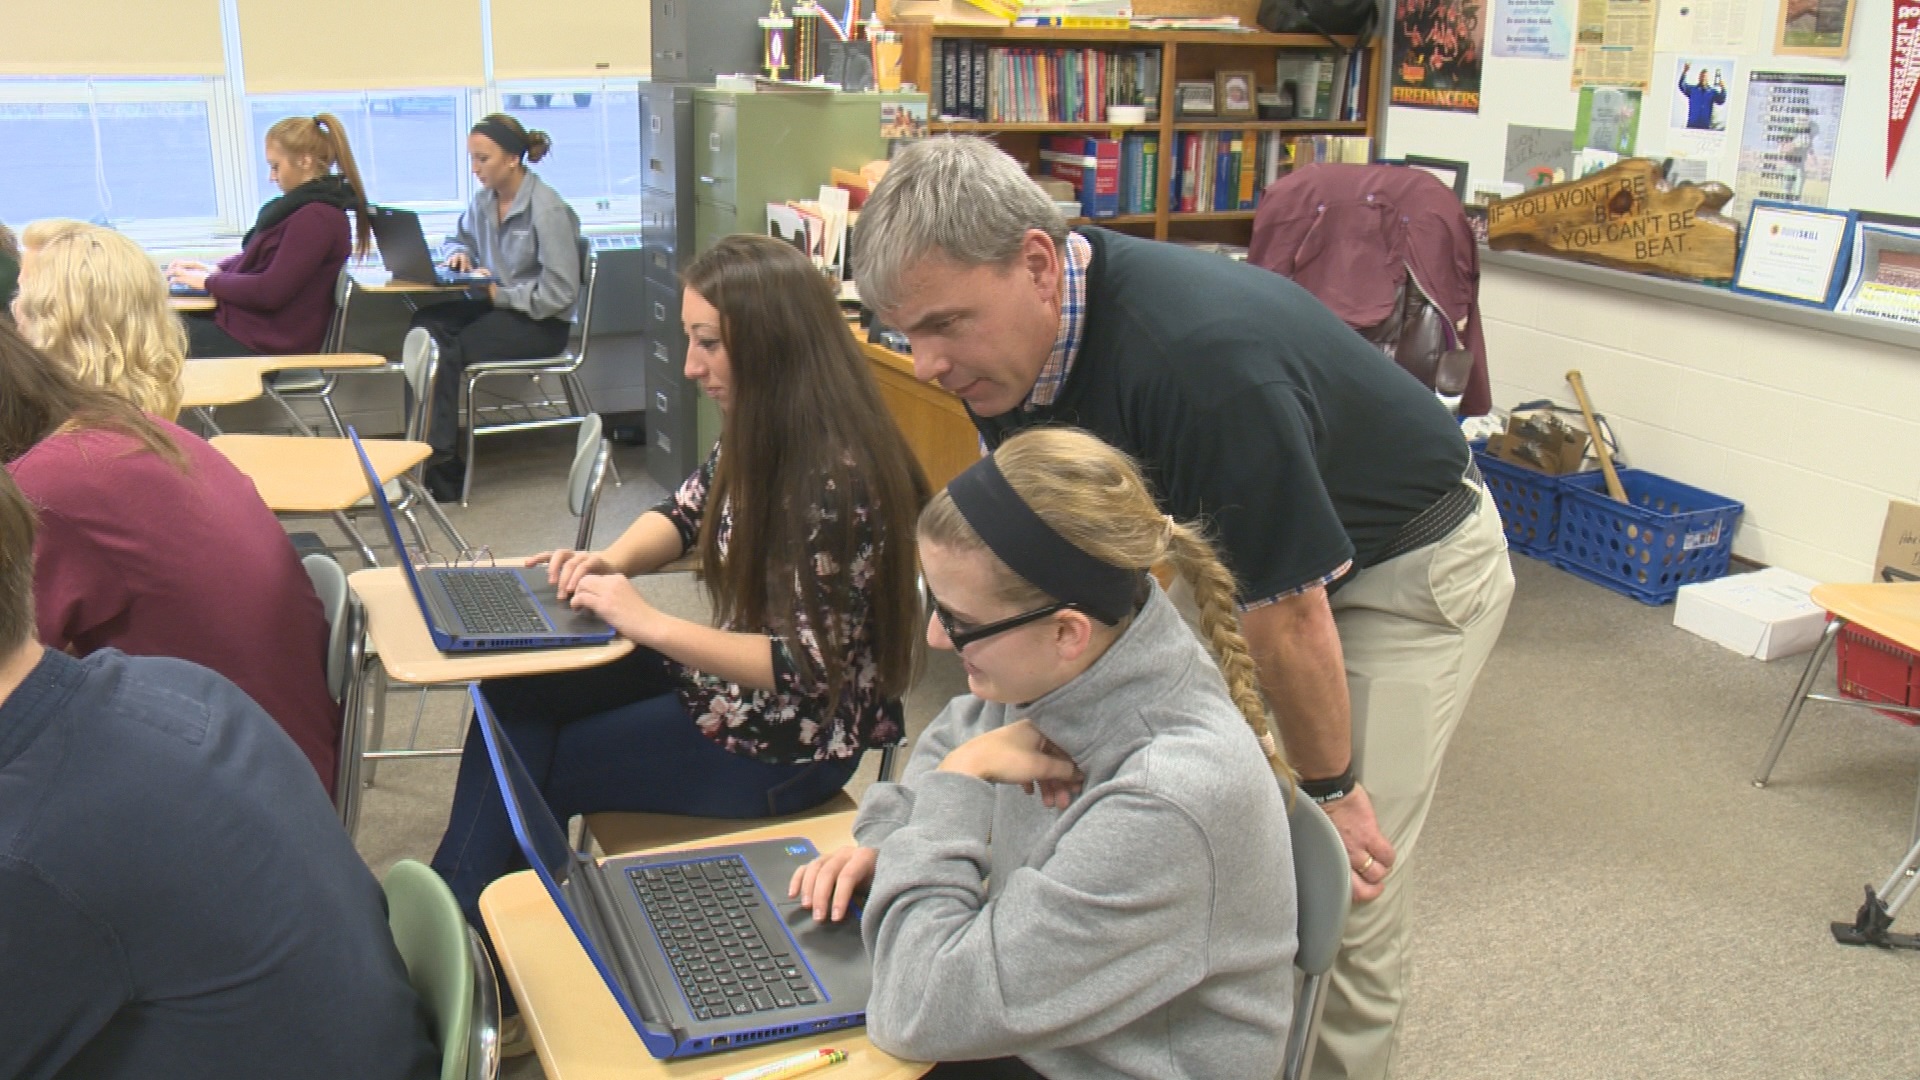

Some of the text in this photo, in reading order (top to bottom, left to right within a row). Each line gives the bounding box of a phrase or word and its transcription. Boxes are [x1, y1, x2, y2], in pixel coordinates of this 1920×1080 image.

[1392, 86, 1479, 107] FIREDANCERS
[1490, 175, 1647, 224] IF YOU WON'T BE
[1561, 208, 1697, 250] YOU CAN'T BE
[1634, 232, 1693, 260] BEAT.
